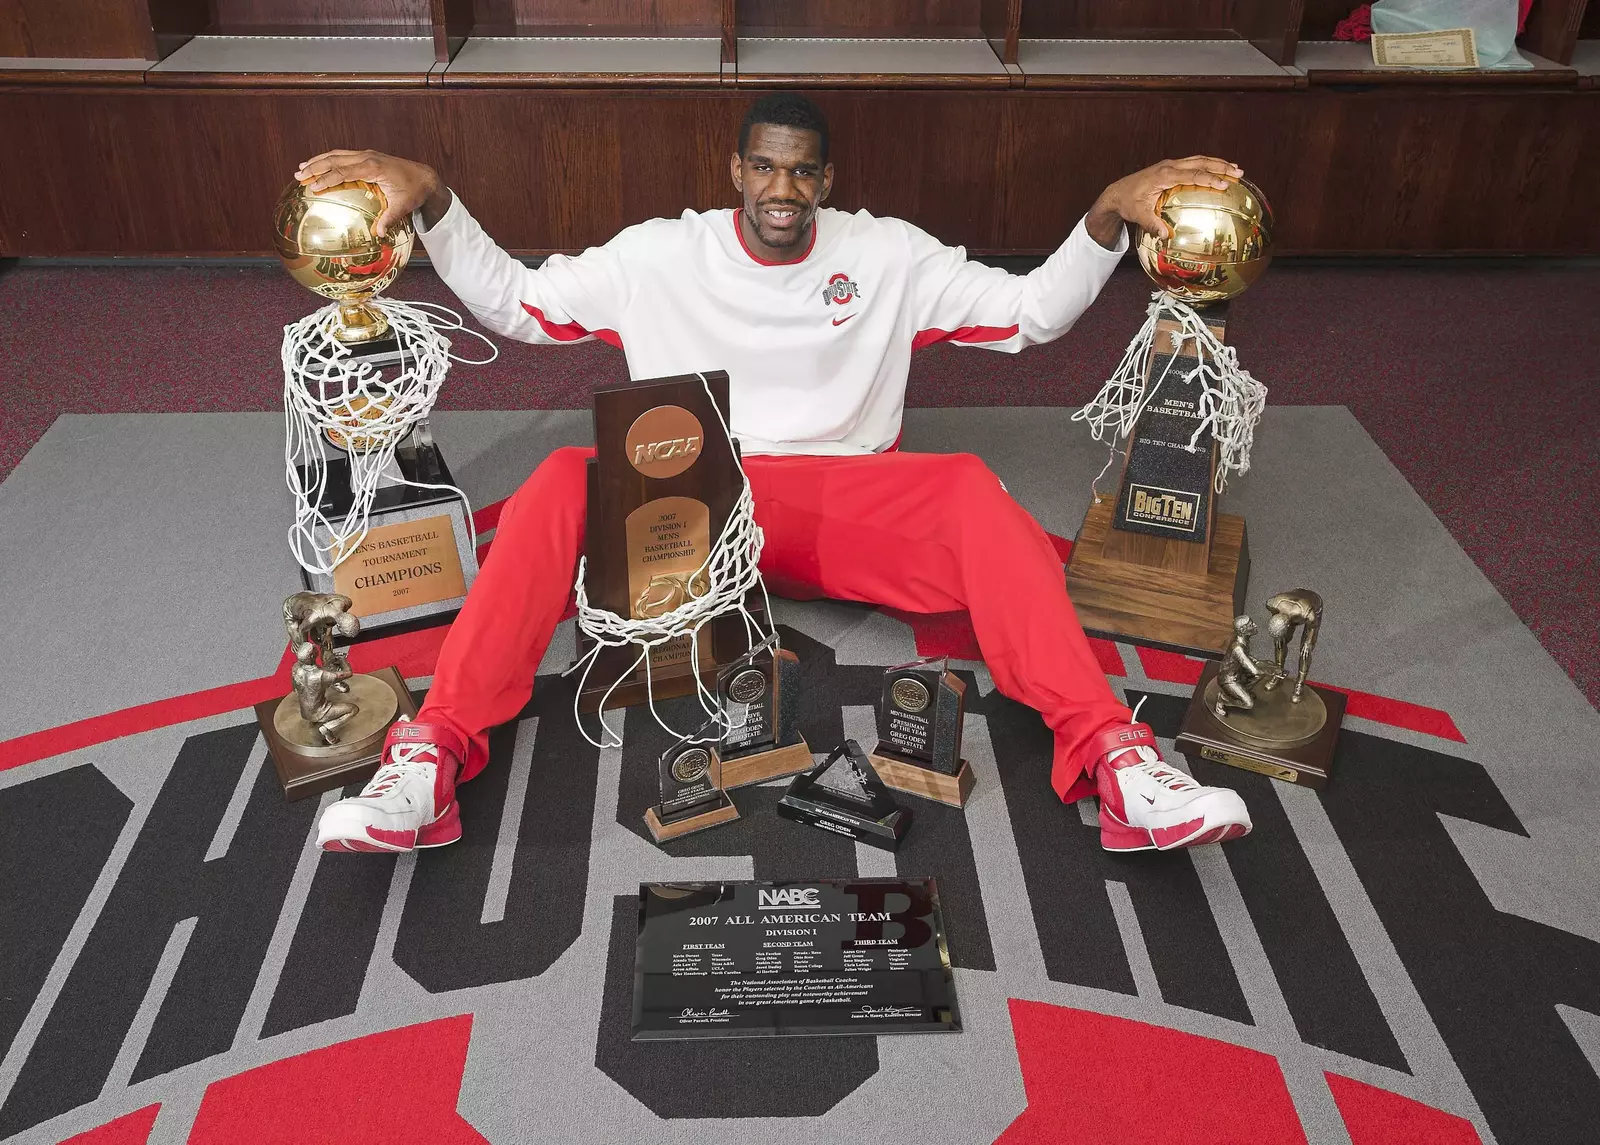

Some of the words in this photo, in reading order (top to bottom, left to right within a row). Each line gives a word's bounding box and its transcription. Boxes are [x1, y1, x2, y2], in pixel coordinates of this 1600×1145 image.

[1164, 399, 1194, 409] MEN'S
[634, 437, 700, 465] NCAA
[659, 513, 677, 521] 2007
[1133, 511, 1190, 526] CONFERENCE
[650, 522, 681, 533] DIVISION
[378, 531, 439, 549] BASKETBALL
[644, 540, 693, 553] BASKETBALL
[362, 548, 428, 567] TOURNAMENT
[642, 549, 696, 563] CHAMPIONSHIP
[354, 562, 442, 589] CHAMPIONS
[392, 587, 410, 597] 2007
[893, 718, 925, 731] FRESHMAN
[899, 725, 911, 733] THE
[911, 728, 927, 737] YEAR
[889, 730, 908, 740] GREG
[908, 735, 926, 745] ODEN
[906, 740, 924, 750] STATE
[835, 824, 852, 833] ODEN
[758, 888, 821, 906] NABC
[689, 916, 719, 927] 2007
[724, 914, 755, 925] ALL
[760, 913, 841, 924] AMERICAN
[848, 912, 892, 922] TEAM
[765, 928, 811, 937] DIVISION
[813, 928, 818, 936] I
